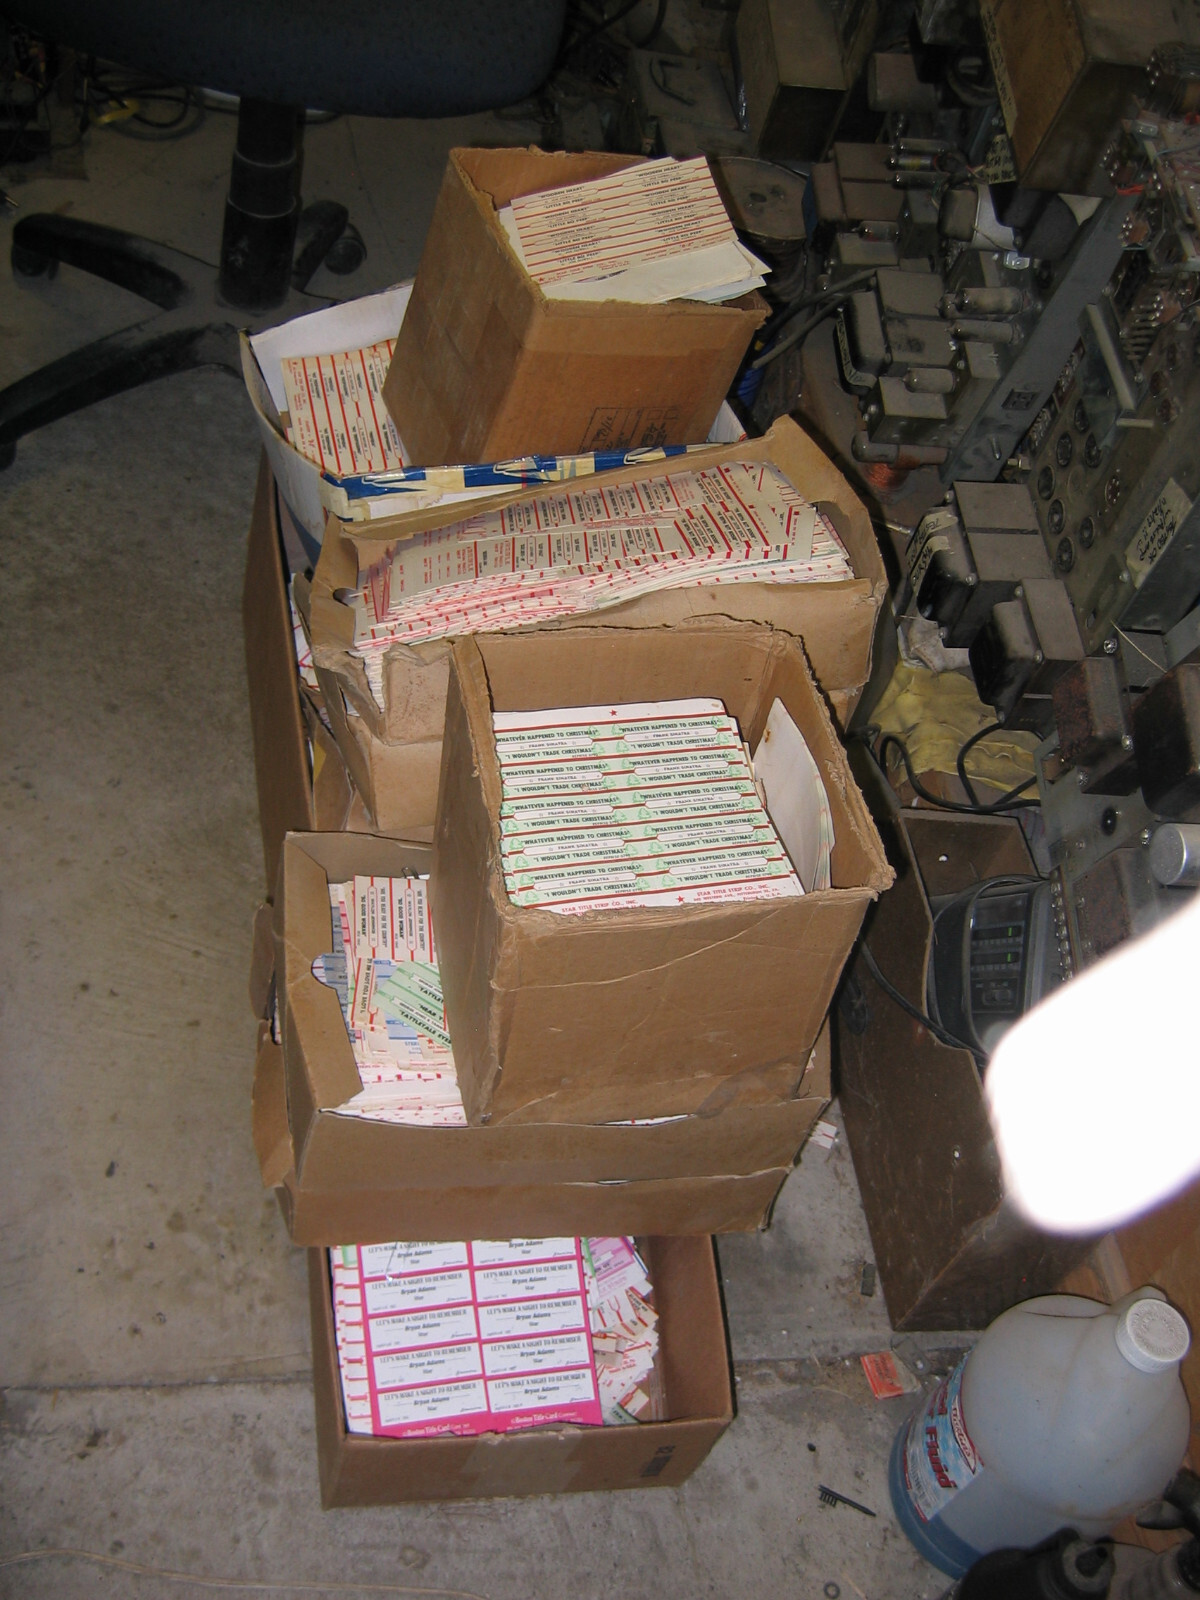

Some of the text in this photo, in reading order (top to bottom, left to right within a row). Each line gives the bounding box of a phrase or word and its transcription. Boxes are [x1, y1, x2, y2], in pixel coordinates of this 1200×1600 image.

[673, 789, 702, 797] HAPPENED
[531, 819, 561, 827] WOULDN'T
[685, 822, 714, 830] HAPPENED
[556, 834, 586, 842] HAPPENED
[671, 840, 701, 848] WOULDN'T
[541, 854, 571, 862] WOULDN'T
[697, 854, 727, 862] HAPPENED
[566, 869, 597, 877] HAPPENED
[684, 873, 714, 881] WOULDN'T
[551, 888, 582, 897] WOULDN'T
[511, 1277, 528, 1285] Bryan
[400, 1287, 417, 1295] Bryan
[515, 1313, 531, 1321] Bryan
[404, 1321, 441, 1332] Bryan Adams
[524, 1387, 540, 1395] Bryan
[413, 1395, 450, 1406] Bryan Adams
[925, 1425, 957, 1488] Fluid
